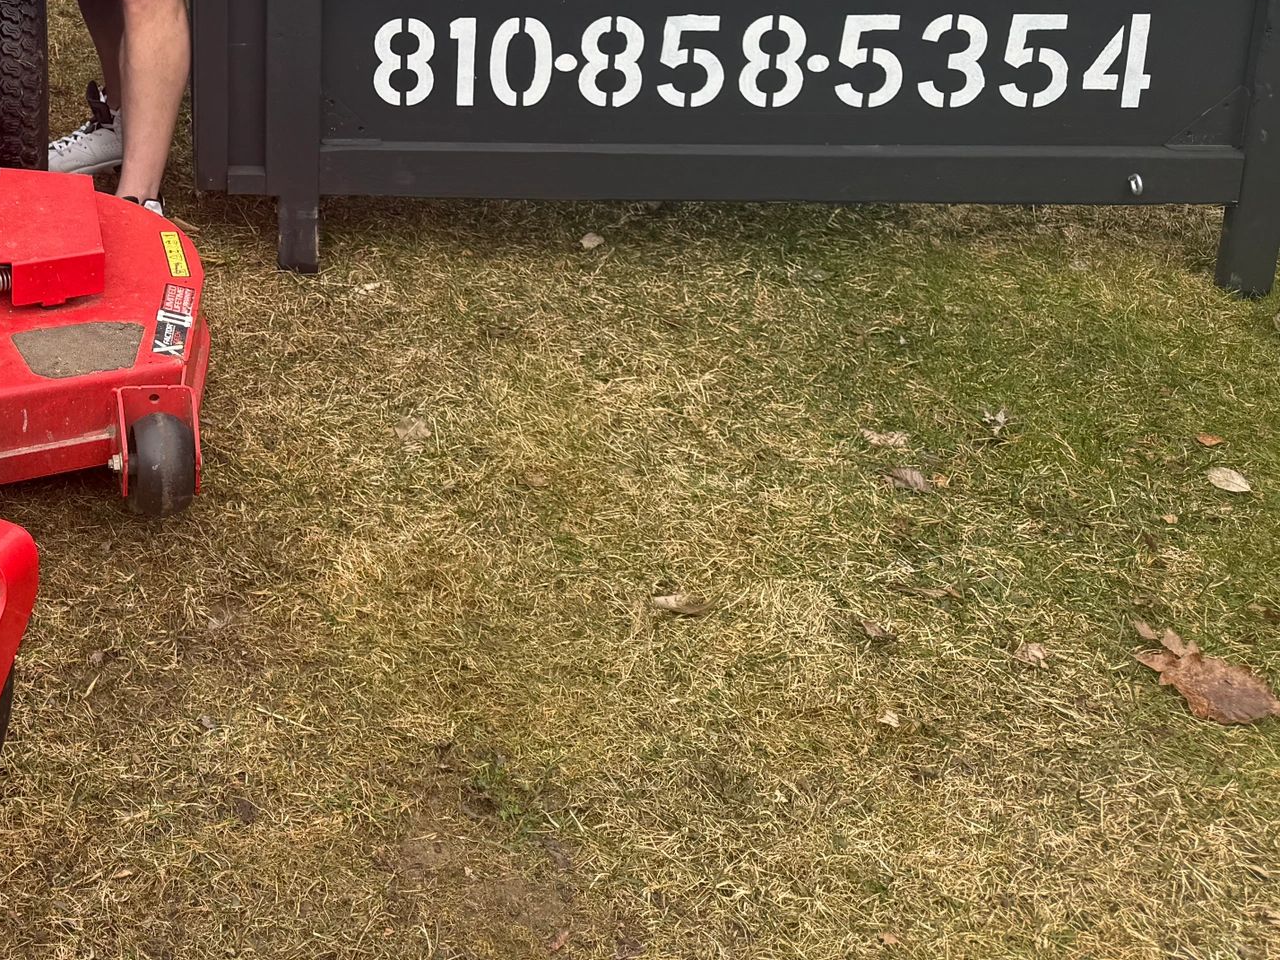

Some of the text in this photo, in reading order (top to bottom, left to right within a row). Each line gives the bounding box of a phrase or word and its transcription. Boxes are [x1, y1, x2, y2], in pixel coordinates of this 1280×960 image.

[162, 285, 178, 311] LIMITED
[162, 323, 174, 345] FACTOR
[152, 339, 184, 357] X
